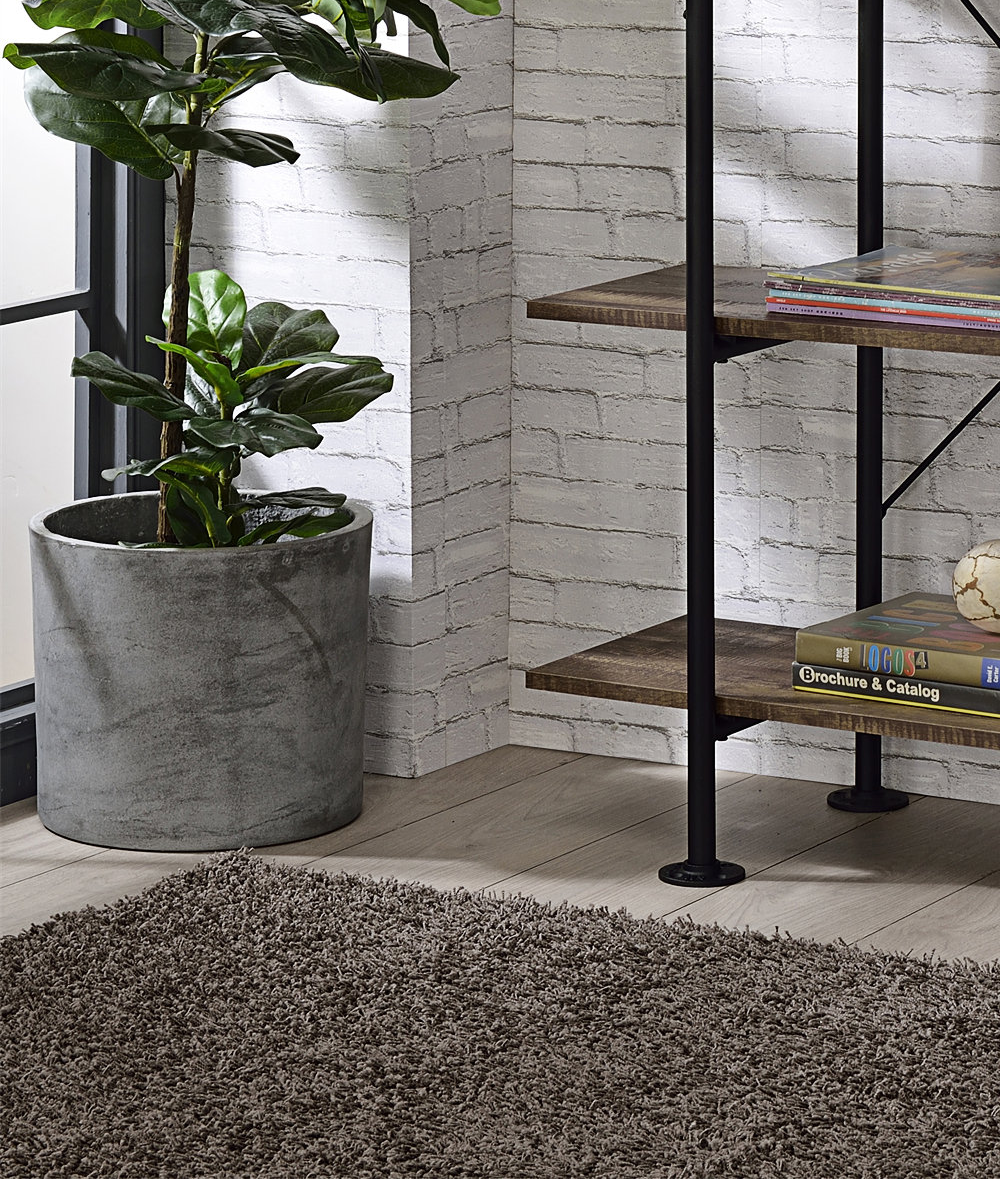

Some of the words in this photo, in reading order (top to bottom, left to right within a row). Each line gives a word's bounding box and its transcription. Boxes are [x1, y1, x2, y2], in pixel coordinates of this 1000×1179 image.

[799, 667, 868, 689] Brochure
[871, 677, 883, 691] &
[886, 679, 940, 702] Catalog
